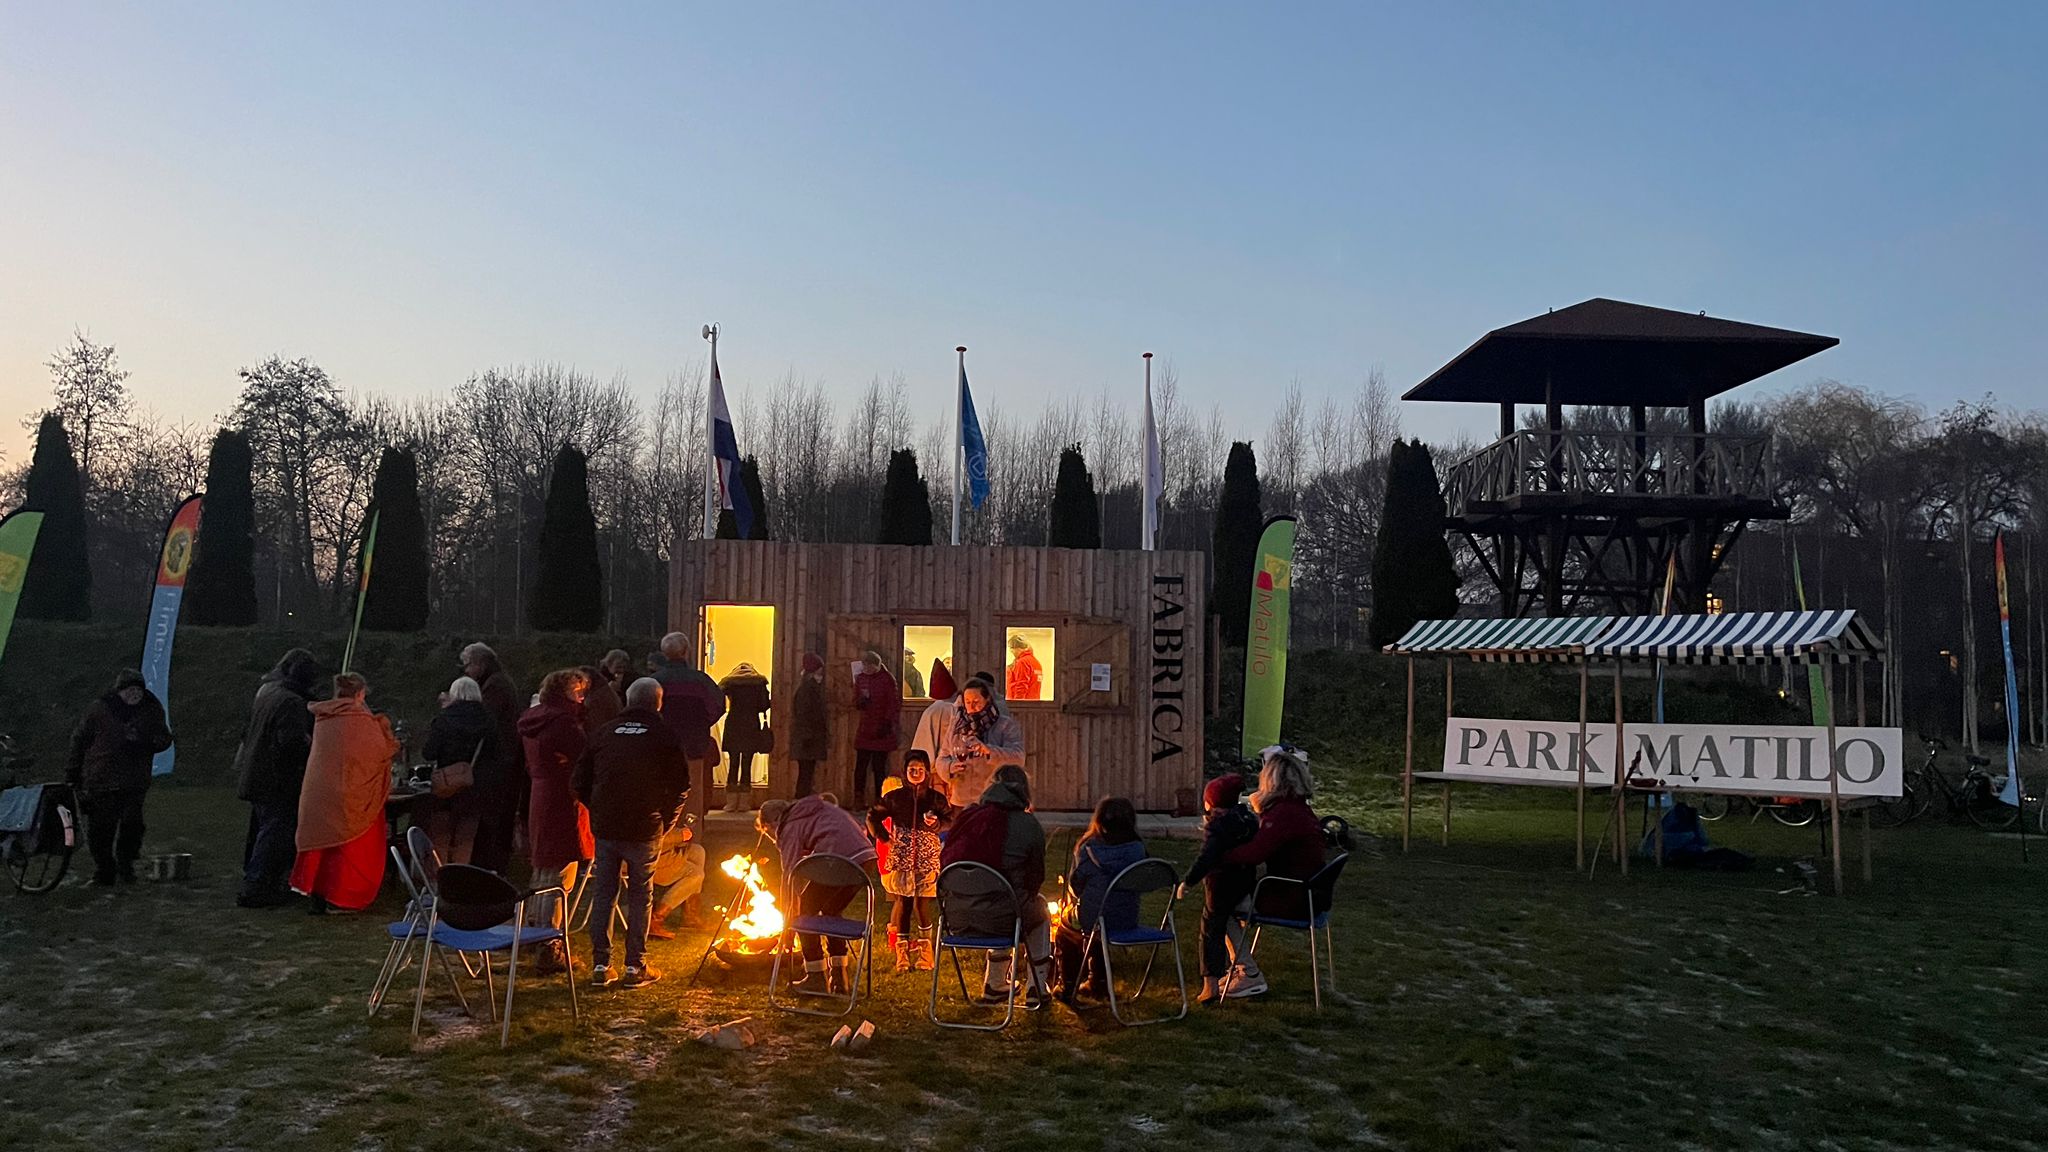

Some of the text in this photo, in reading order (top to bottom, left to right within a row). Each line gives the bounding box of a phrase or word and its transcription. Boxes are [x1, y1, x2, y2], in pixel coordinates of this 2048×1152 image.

[1152, 575, 1184, 765] FABRICA
[1252, 592, 1274, 676] Matilo
[1457, 727, 1885, 784] PARK MATILO
